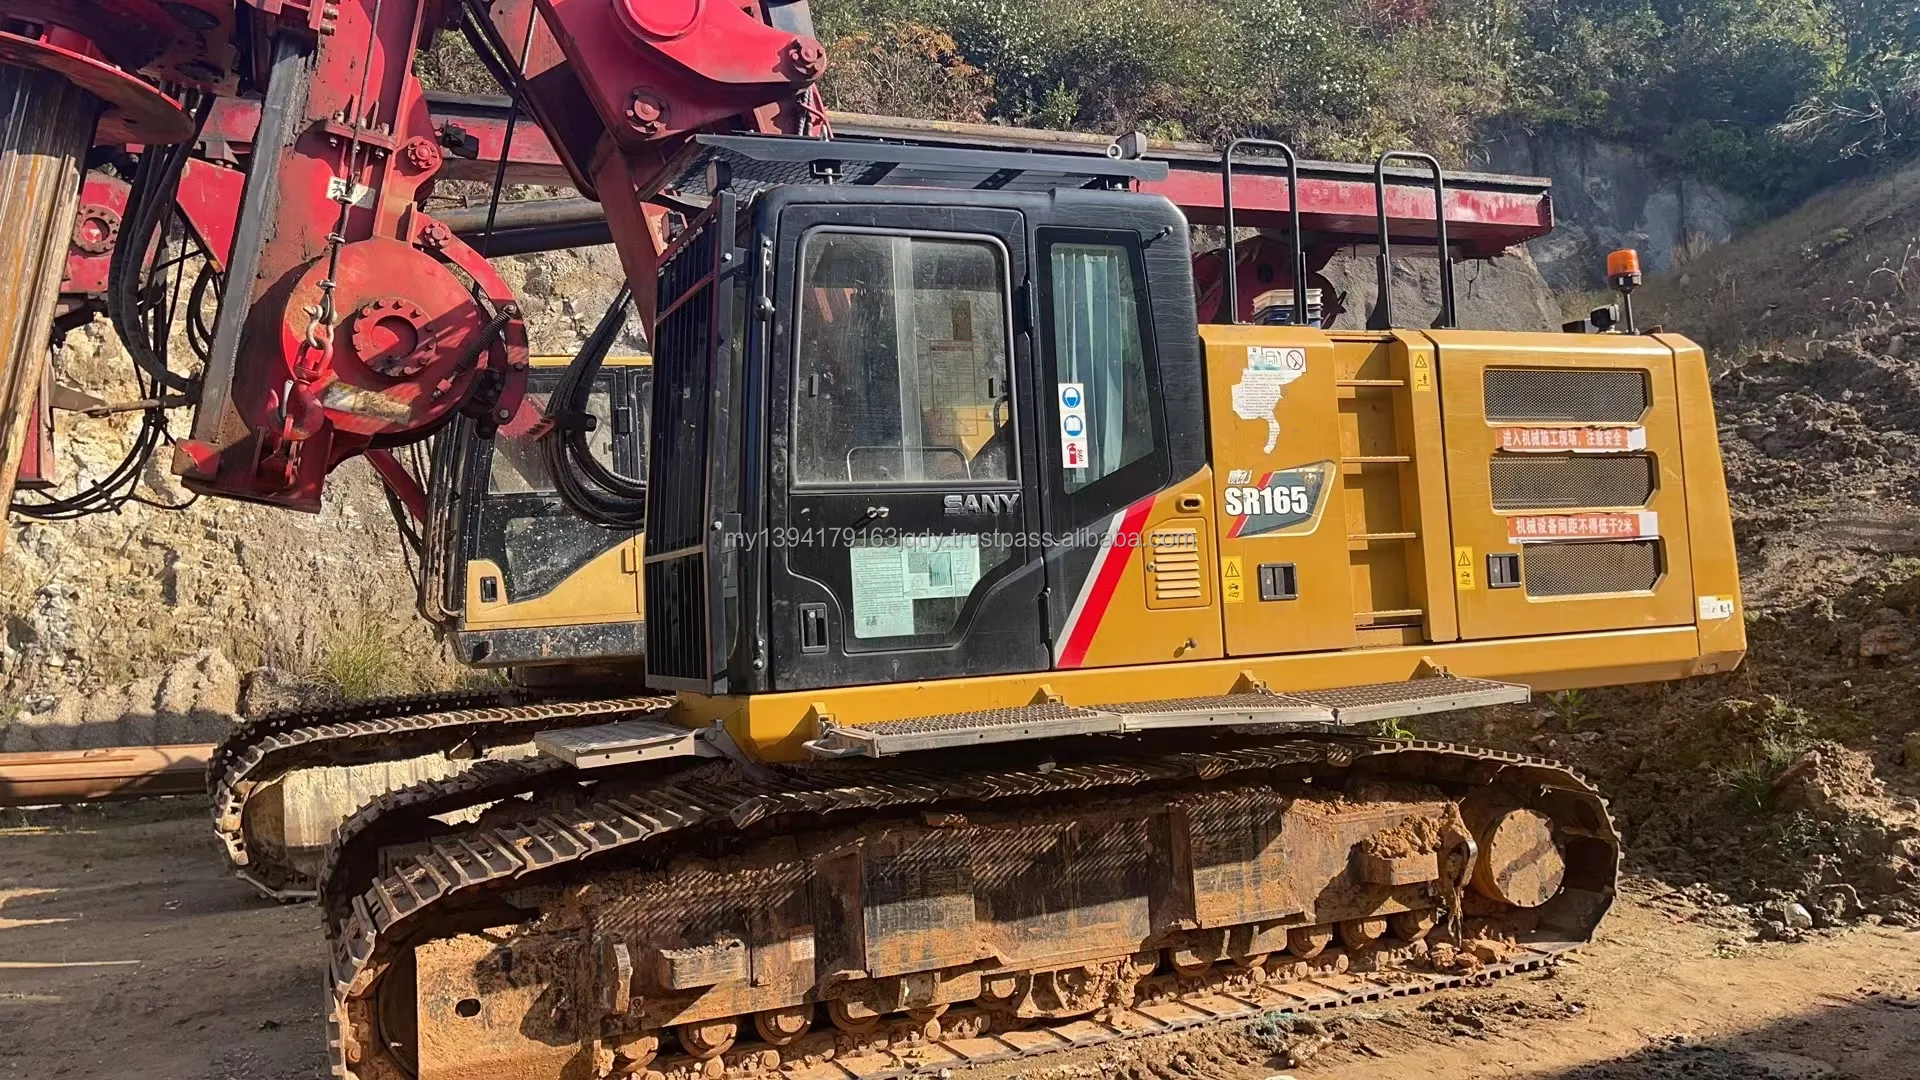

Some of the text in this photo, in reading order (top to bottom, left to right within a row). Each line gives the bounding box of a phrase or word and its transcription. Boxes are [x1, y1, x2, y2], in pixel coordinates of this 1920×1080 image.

[944, 494, 1019, 514] SANY
[1224, 486, 1309, 516] SR165
[1515, 517, 1634, 535] 机械设备间距不得低于2米
